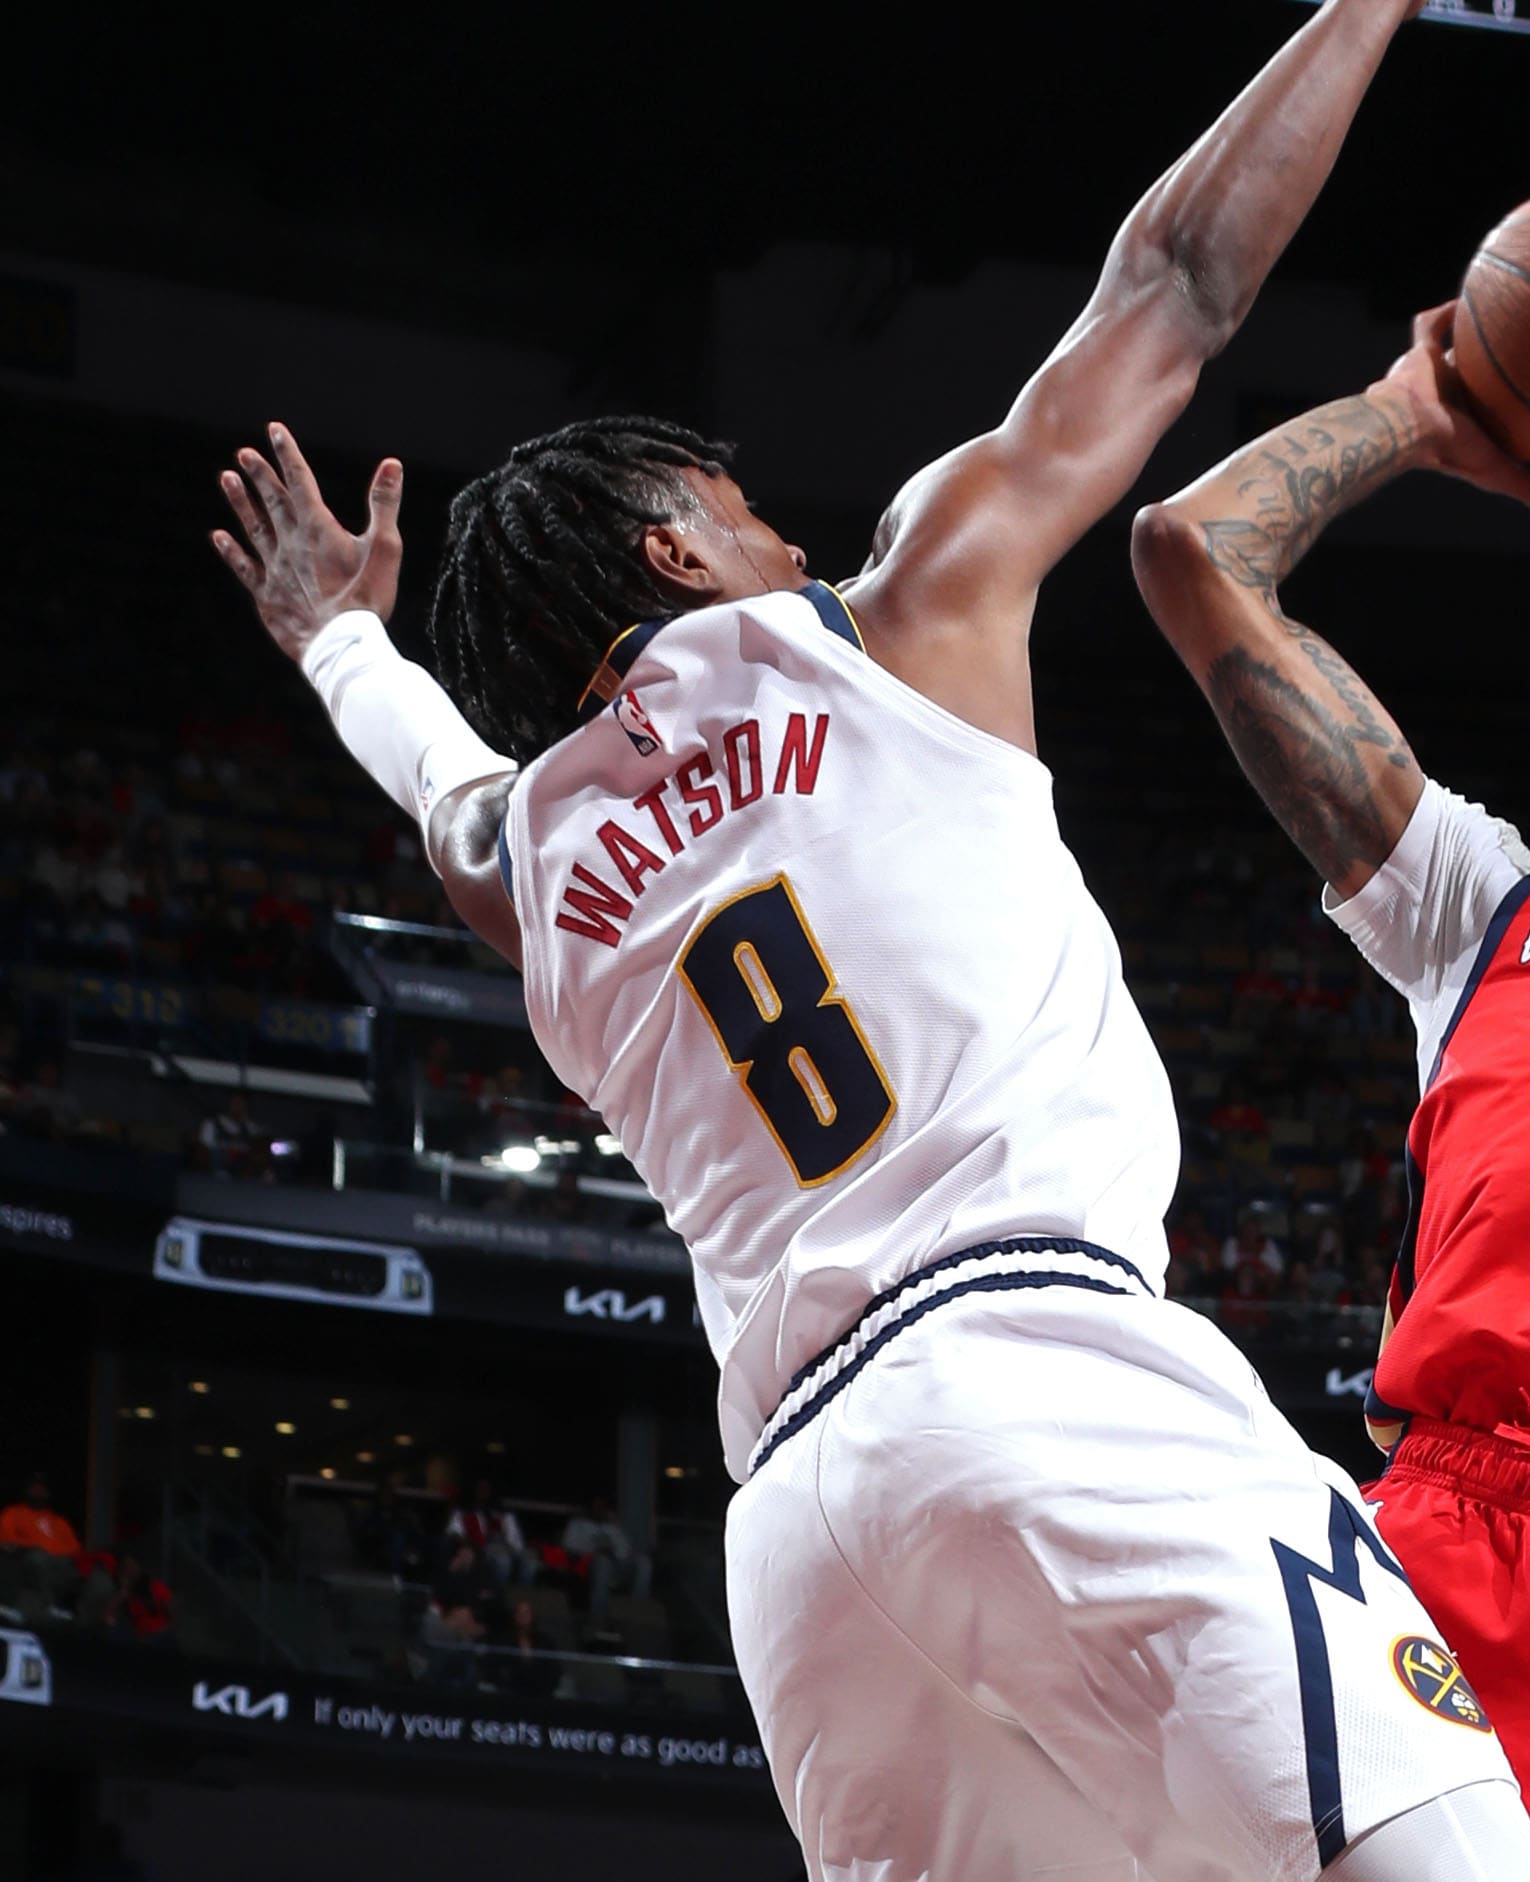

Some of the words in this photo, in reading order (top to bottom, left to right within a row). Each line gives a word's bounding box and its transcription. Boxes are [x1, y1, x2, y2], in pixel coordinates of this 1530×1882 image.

[555, 713, 829, 948] WATSON
[676, 871, 898, 1189] 8
[563, 1276, 667, 1325] KIA
[192, 1680, 290, 1722] KIA
[314, 1696, 334, 1725] If
[337, 1704, 396, 1739] only
[401, 1712, 464, 1743] your
[470, 1717, 543, 1748] seats
[548, 1725, 616, 1755] were
[620, 1733, 652, 1759] as
[657, 1736, 728, 1766] good
[732, 1743, 766, 1769] as
